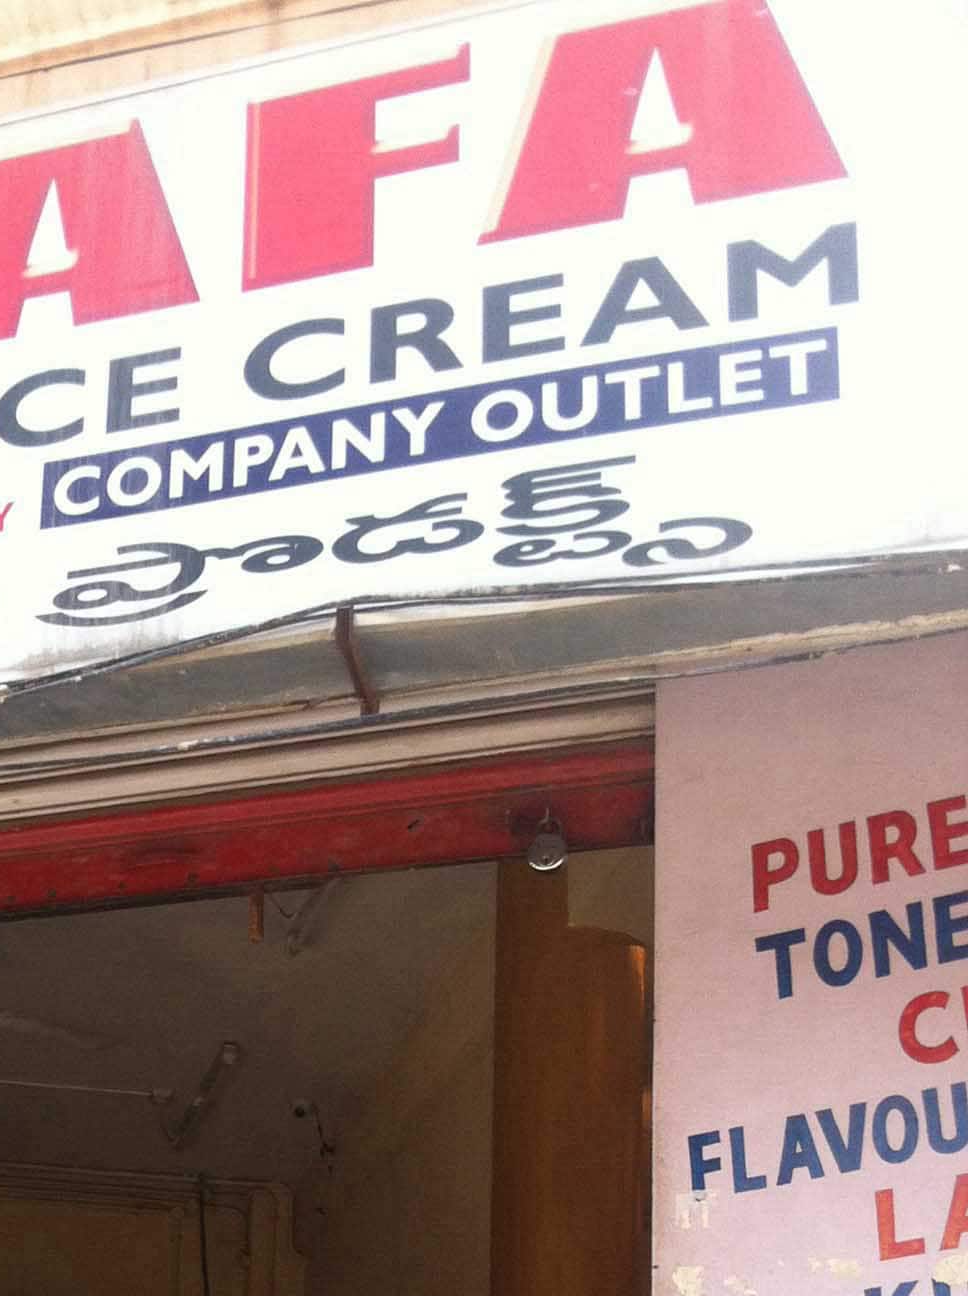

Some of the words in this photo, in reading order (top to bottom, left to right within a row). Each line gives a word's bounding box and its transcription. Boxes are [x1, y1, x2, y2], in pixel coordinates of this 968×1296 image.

[243, 221, 859, 401] CREAM
[53, 405, 445, 516] COMPANY
[471, 338, 827, 442] OUTLET
[750, 795, 968, 914] PURE
[898, 985, 968, 1064] C
[687, 1081, 968, 1194] FLAVOU
